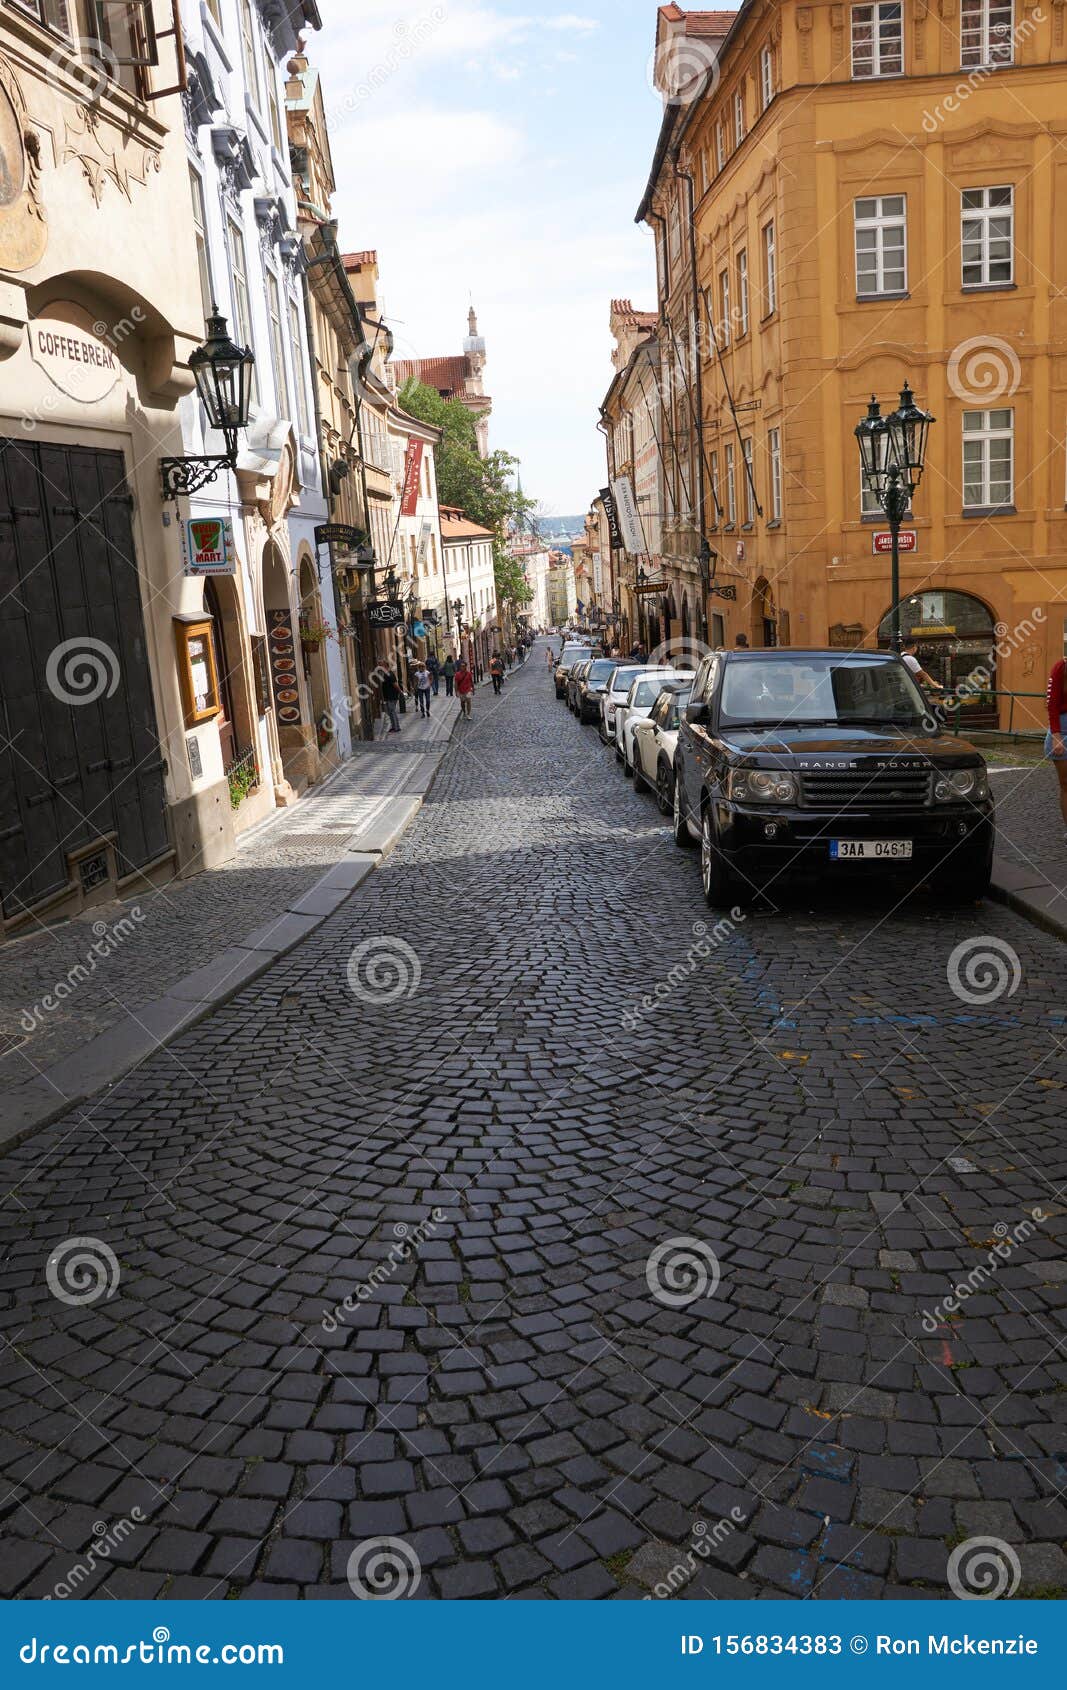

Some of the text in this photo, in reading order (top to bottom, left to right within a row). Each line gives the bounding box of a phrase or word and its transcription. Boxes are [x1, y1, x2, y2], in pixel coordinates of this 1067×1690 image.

[38, 331, 116, 370] COFFEE BREAK
[603, 497, 618, 537] VISITOR
[196, 553, 222, 563] MART
[840, 843, 906, 857] 3AA 0461
